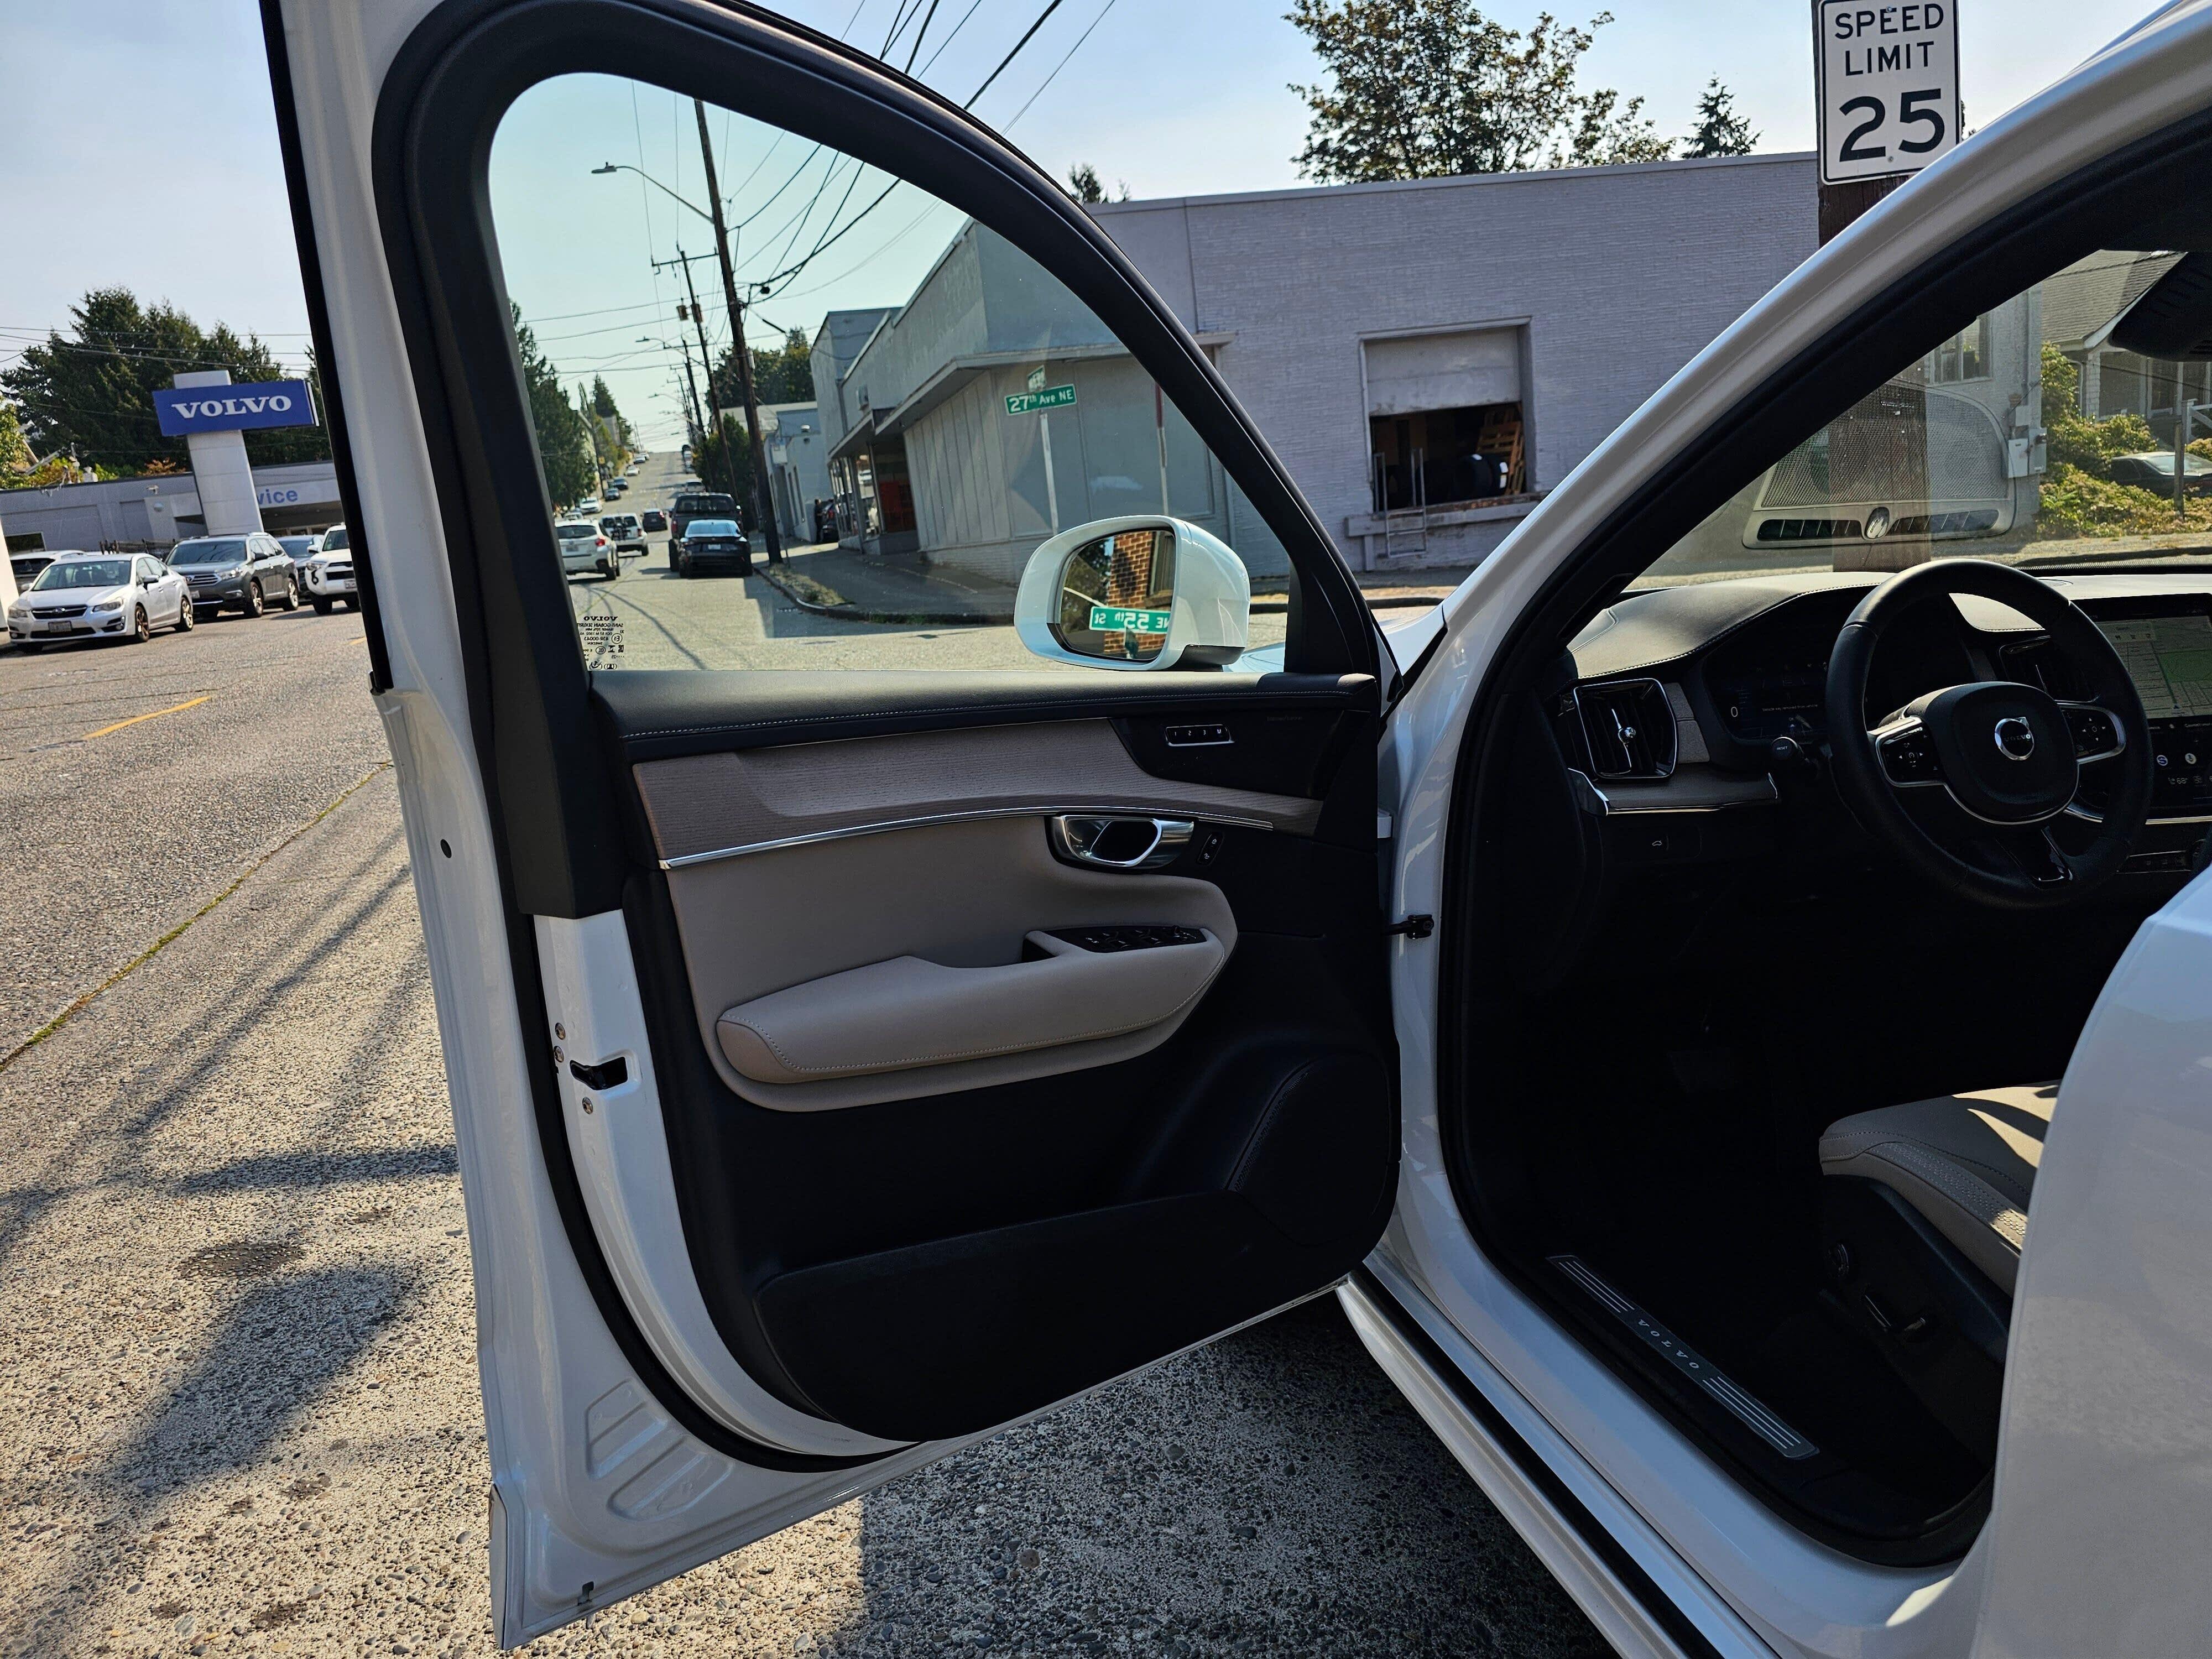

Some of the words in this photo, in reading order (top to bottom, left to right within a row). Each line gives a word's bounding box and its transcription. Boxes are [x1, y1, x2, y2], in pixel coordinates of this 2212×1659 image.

[1834, 3, 1944, 39] SPEED
[1845, 41, 1934, 76] LIMIT
[1839, 88, 1945, 162] 25
[171, 395, 292, 419] VOLVO
[1009, 395, 1037, 412] 27th
[1039, 394, 1056, 405] Ave
[1058, 389, 1073, 401] NE
[1638, 1319, 1699, 1369] VOLVO
